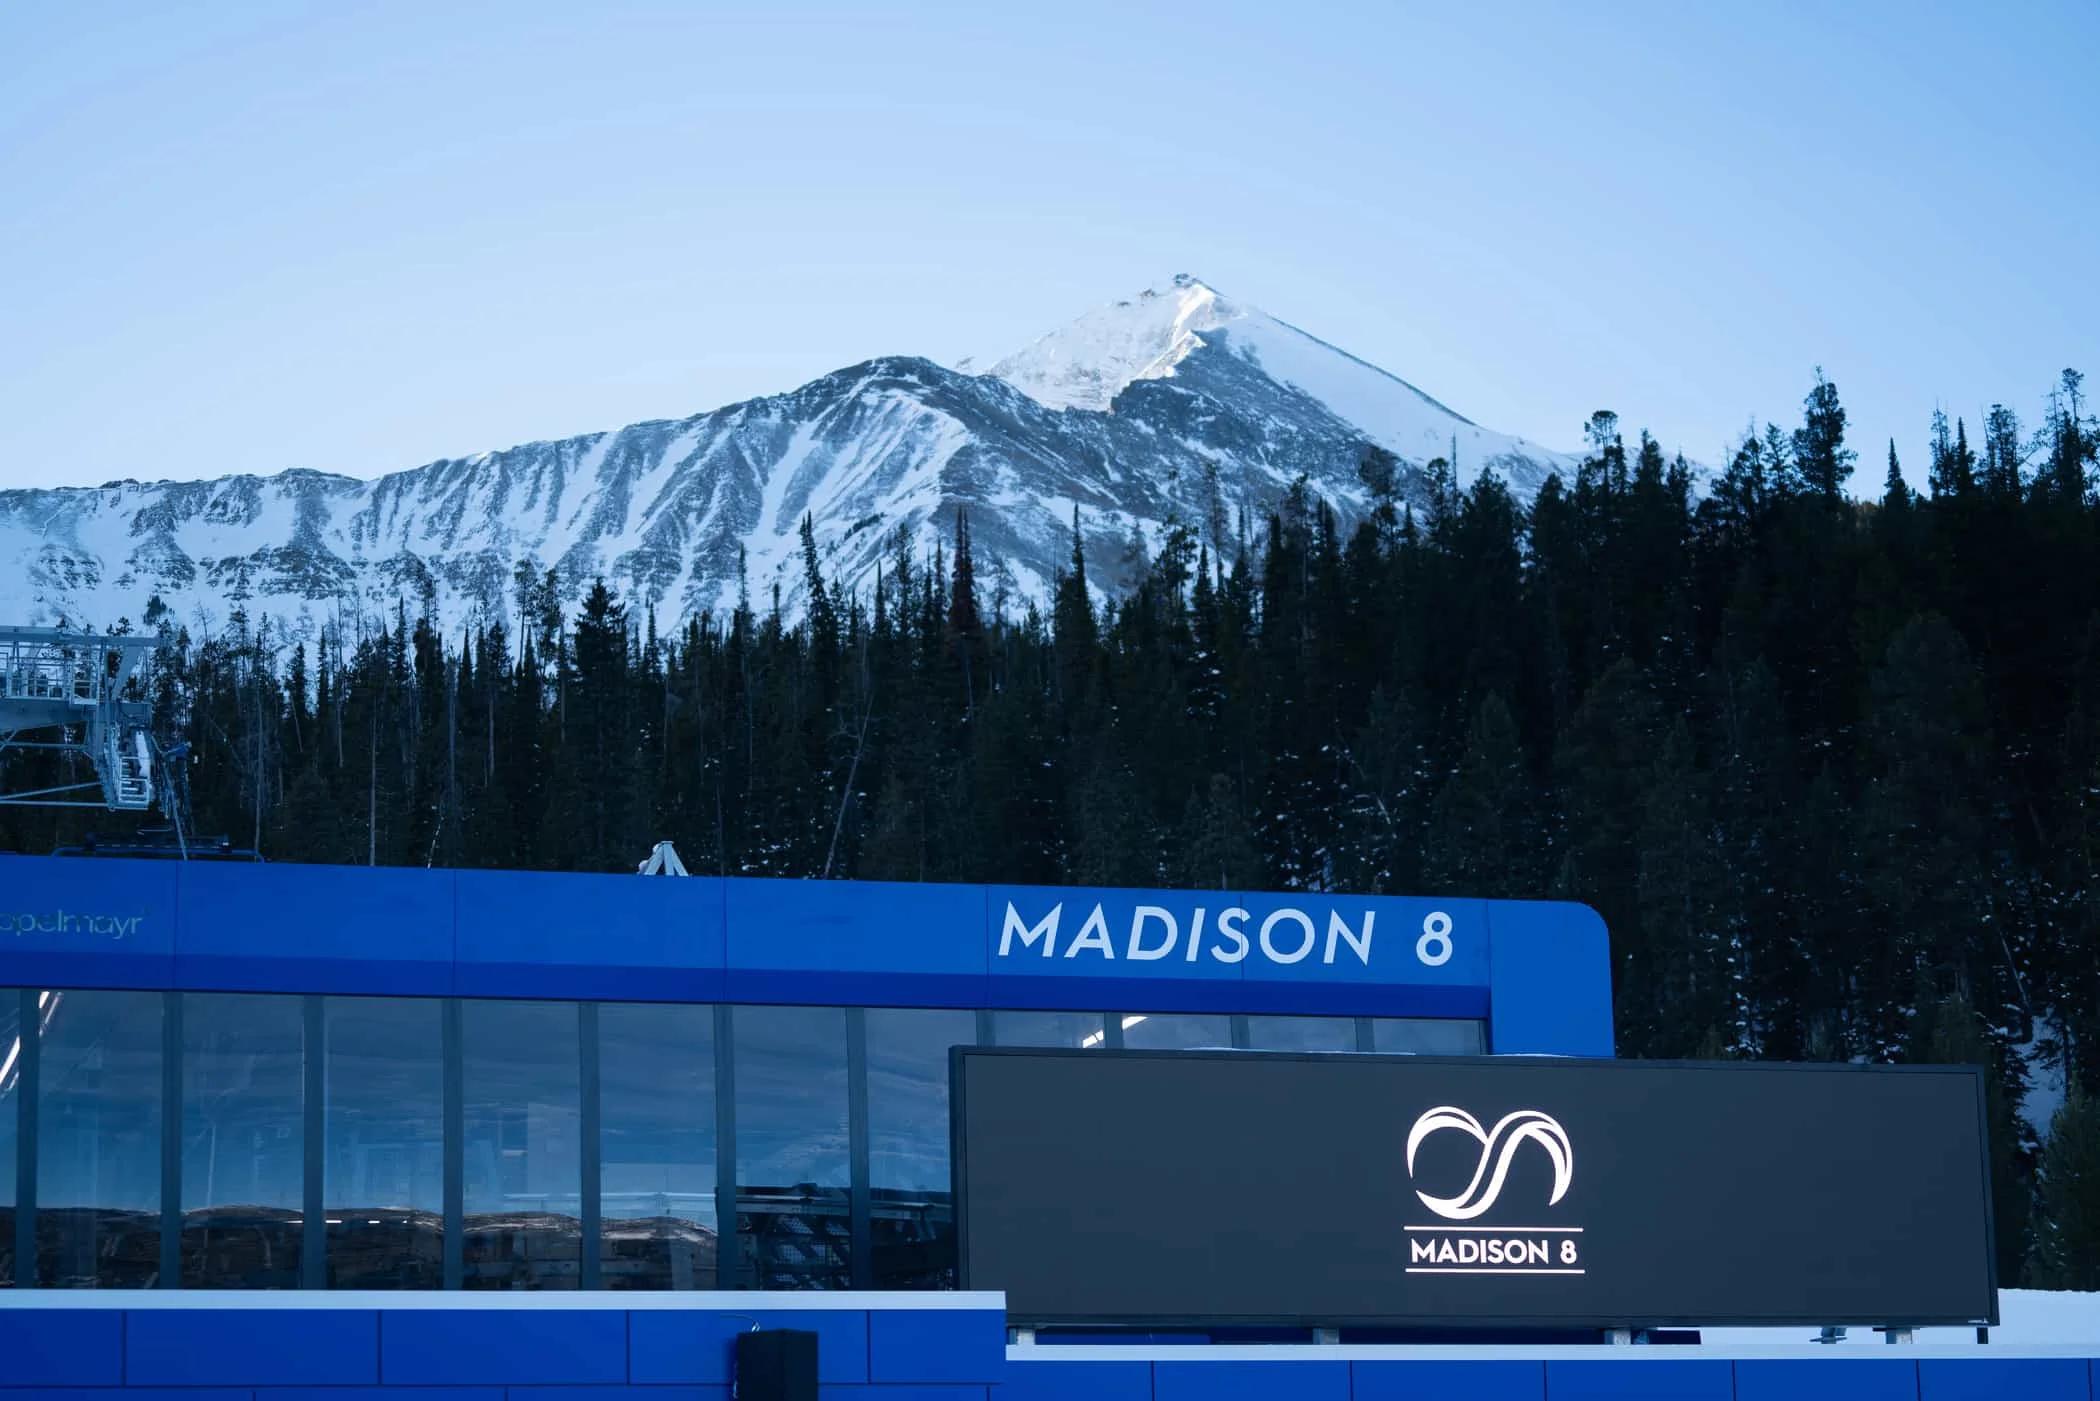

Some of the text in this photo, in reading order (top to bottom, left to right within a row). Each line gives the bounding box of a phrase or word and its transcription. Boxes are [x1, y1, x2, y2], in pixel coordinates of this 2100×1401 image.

[998, 901, 1453, 966] MADISON 8
[1411, 1238, 1577, 1264] MADISON 8
